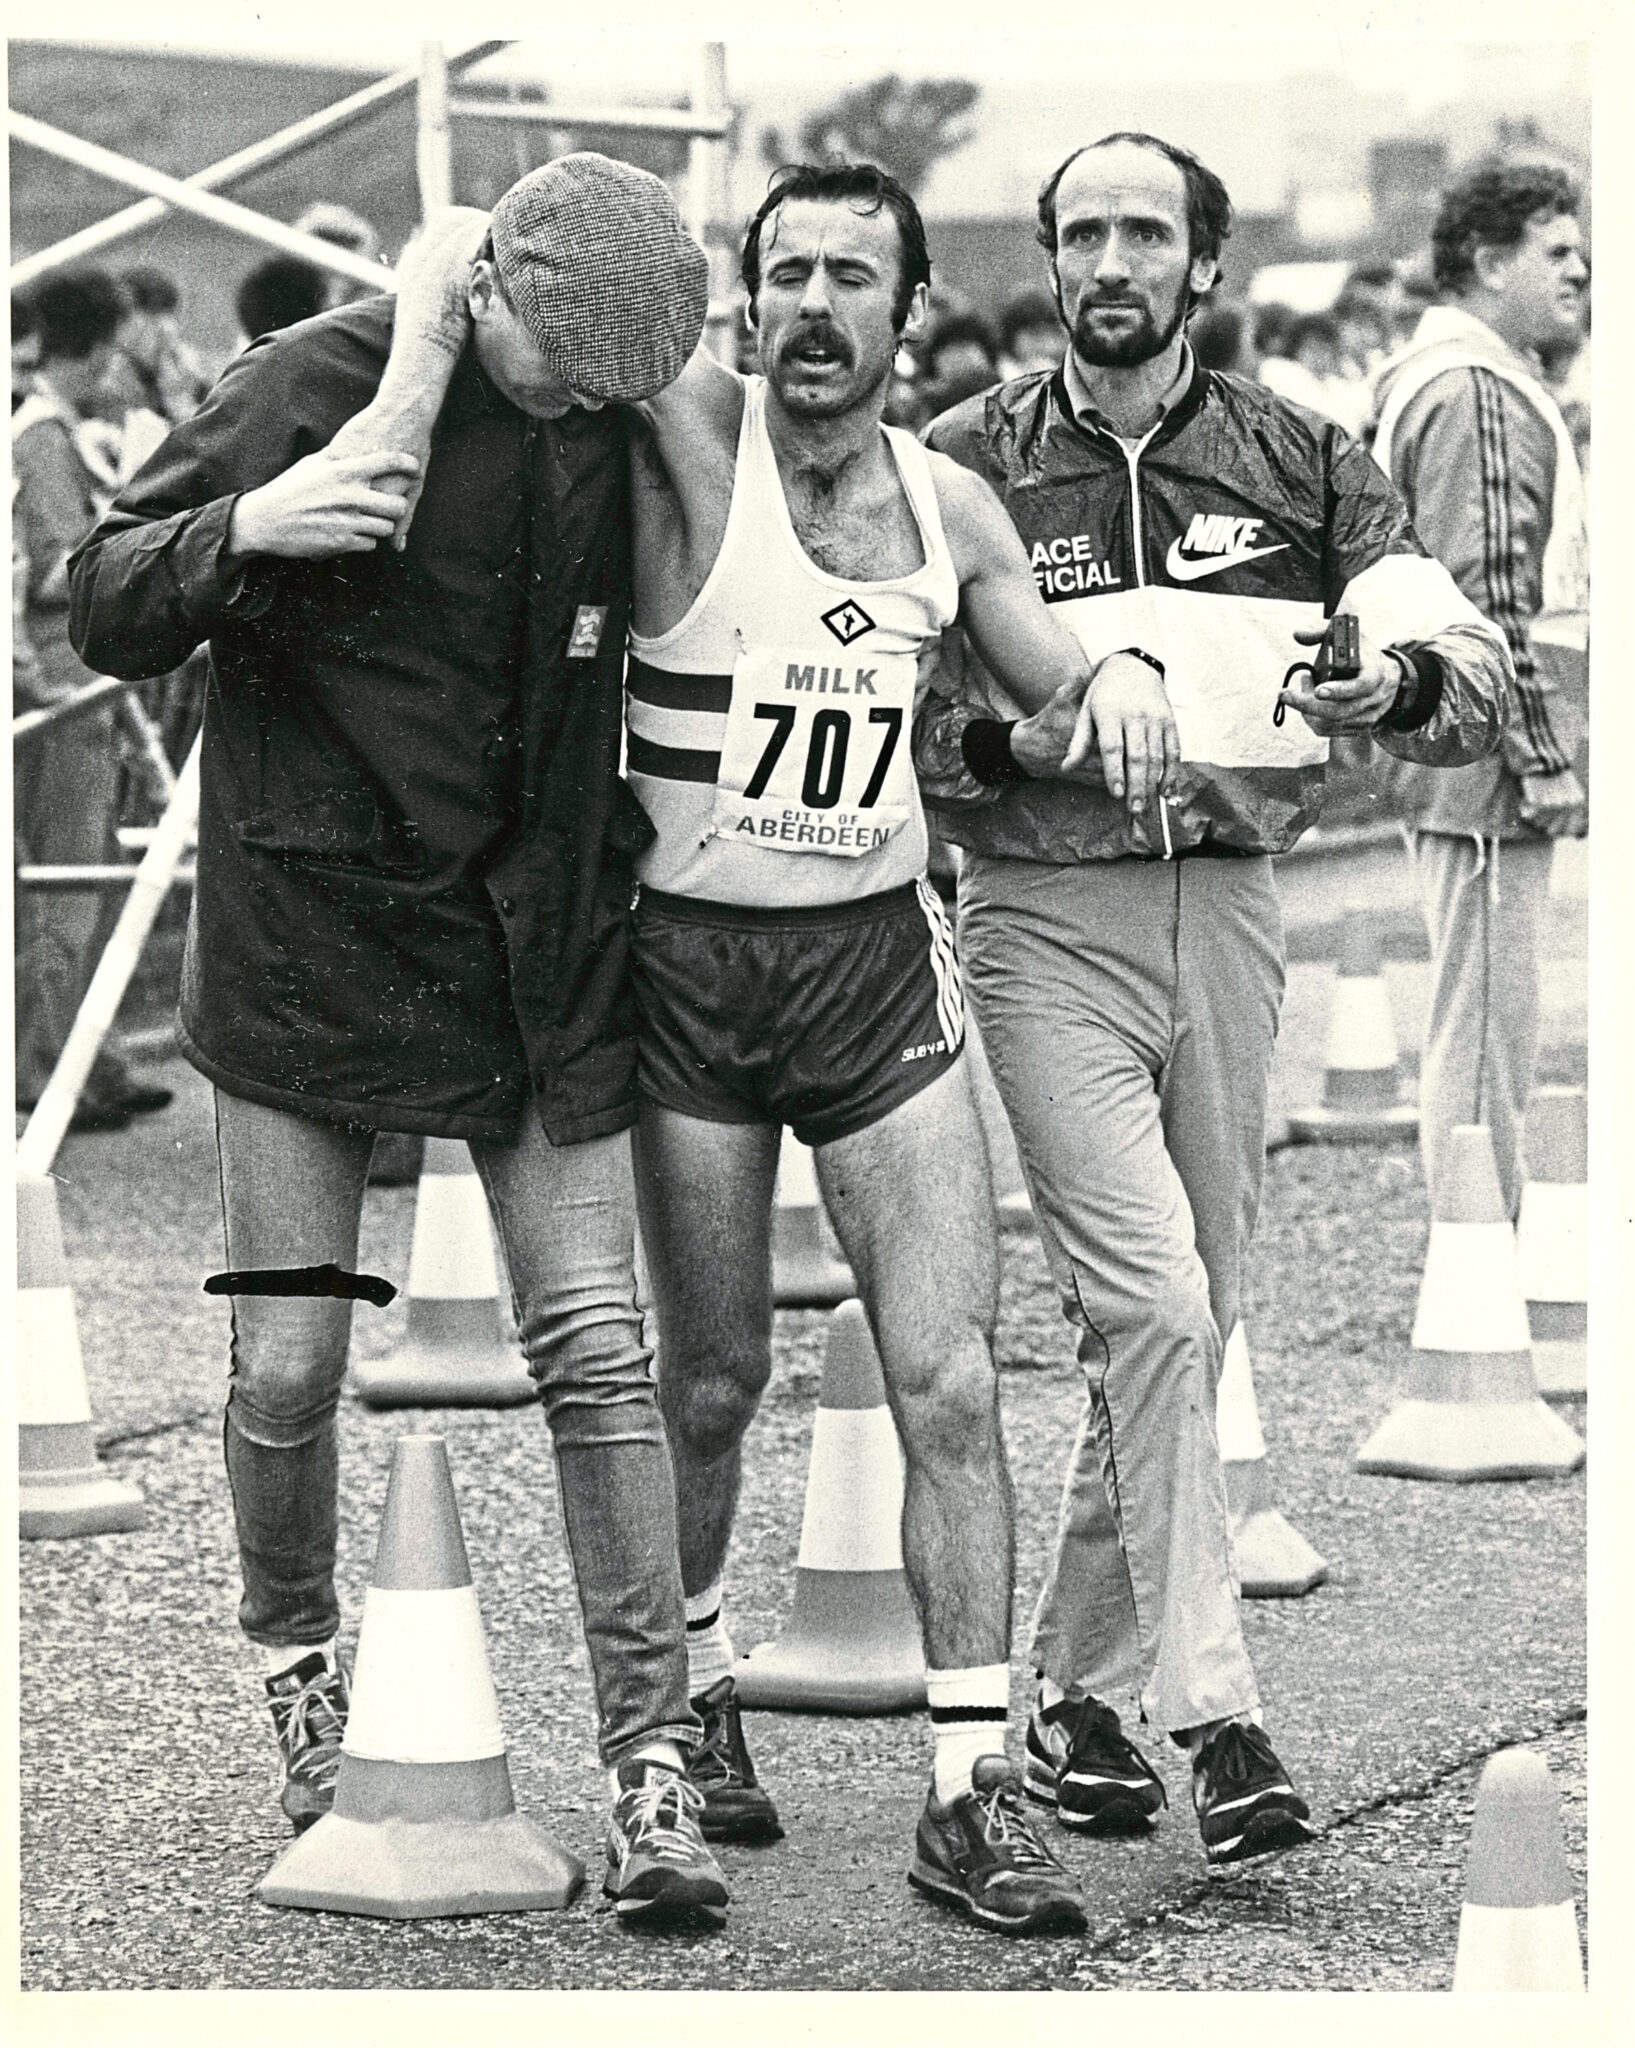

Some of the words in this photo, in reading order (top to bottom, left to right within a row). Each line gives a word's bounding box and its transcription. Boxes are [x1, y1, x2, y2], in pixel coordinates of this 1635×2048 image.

[1181, 513, 1264, 554] NIKE
[1031, 535, 1092, 567] ACE
[1033, 560, 1121, 594] FICIAL
[784, 663, 878, 695] MILK
[743, 702, 903, 809] 707
[735, 815, 890, 847] ABERDEEN
[782, 809, 825, 824] CITY
[838, 813, 859, 825] OF
